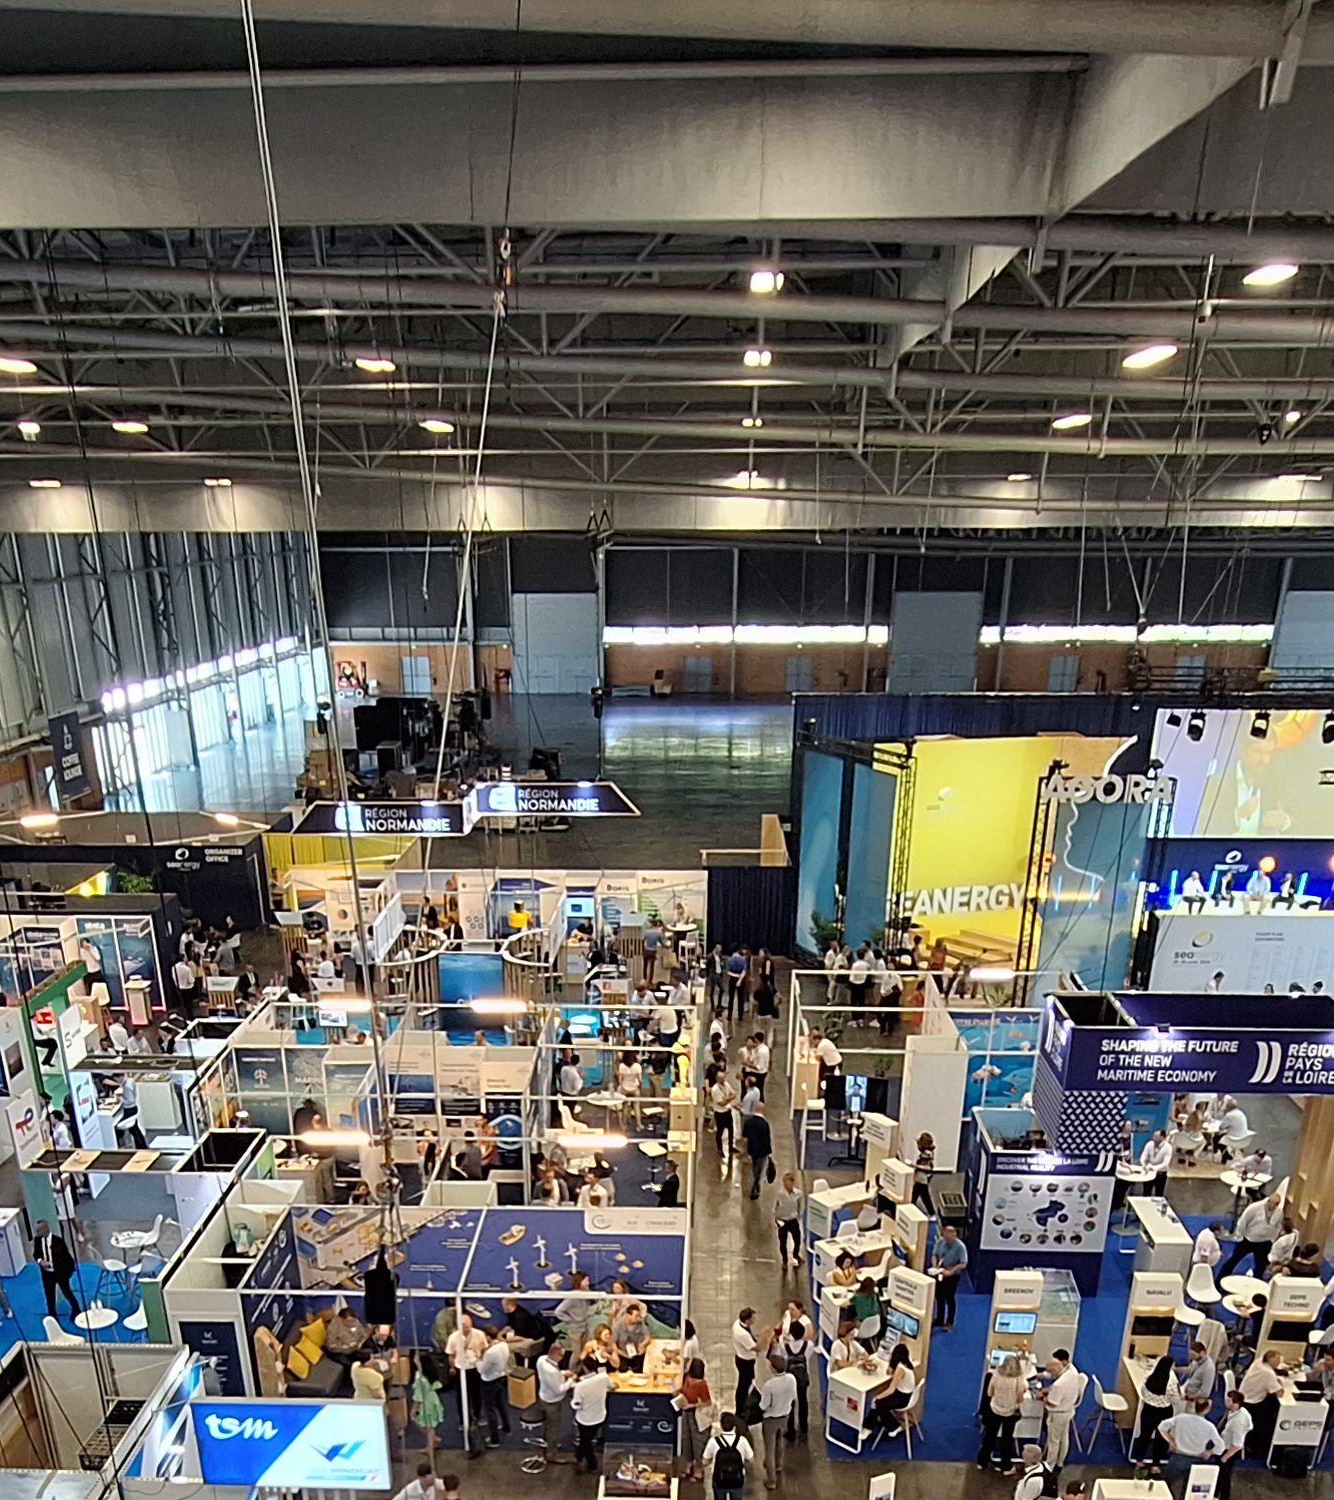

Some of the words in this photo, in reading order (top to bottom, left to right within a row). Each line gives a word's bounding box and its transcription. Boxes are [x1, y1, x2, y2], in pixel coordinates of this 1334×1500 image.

[518, 787, 559, 800] RÉGION
[1041, 774, 1175, 804] AGORA
[518, 798, 599, 812] NORMANDIE
[365, 807, 407, 819] RÉGION
[365, 818, 451, 832] NORMANDIE
[888, 884, 1026, 920] EANERGY
[1187, 1040, 1239, 1053] FUTURE
[1099, 1054, 1116, 1066] OF
[1118, 1054, 1142, 1067] THE
[1143, 1055, 1172, 1067] NEW
[1285, 1057, 1323, 1070] PAYS
[1097, 1069, 1155, 1081] MARITIME
[1157, 1070, 1217, 1083] ECONOMY
[204, 1413, 279, 1440] tsm
